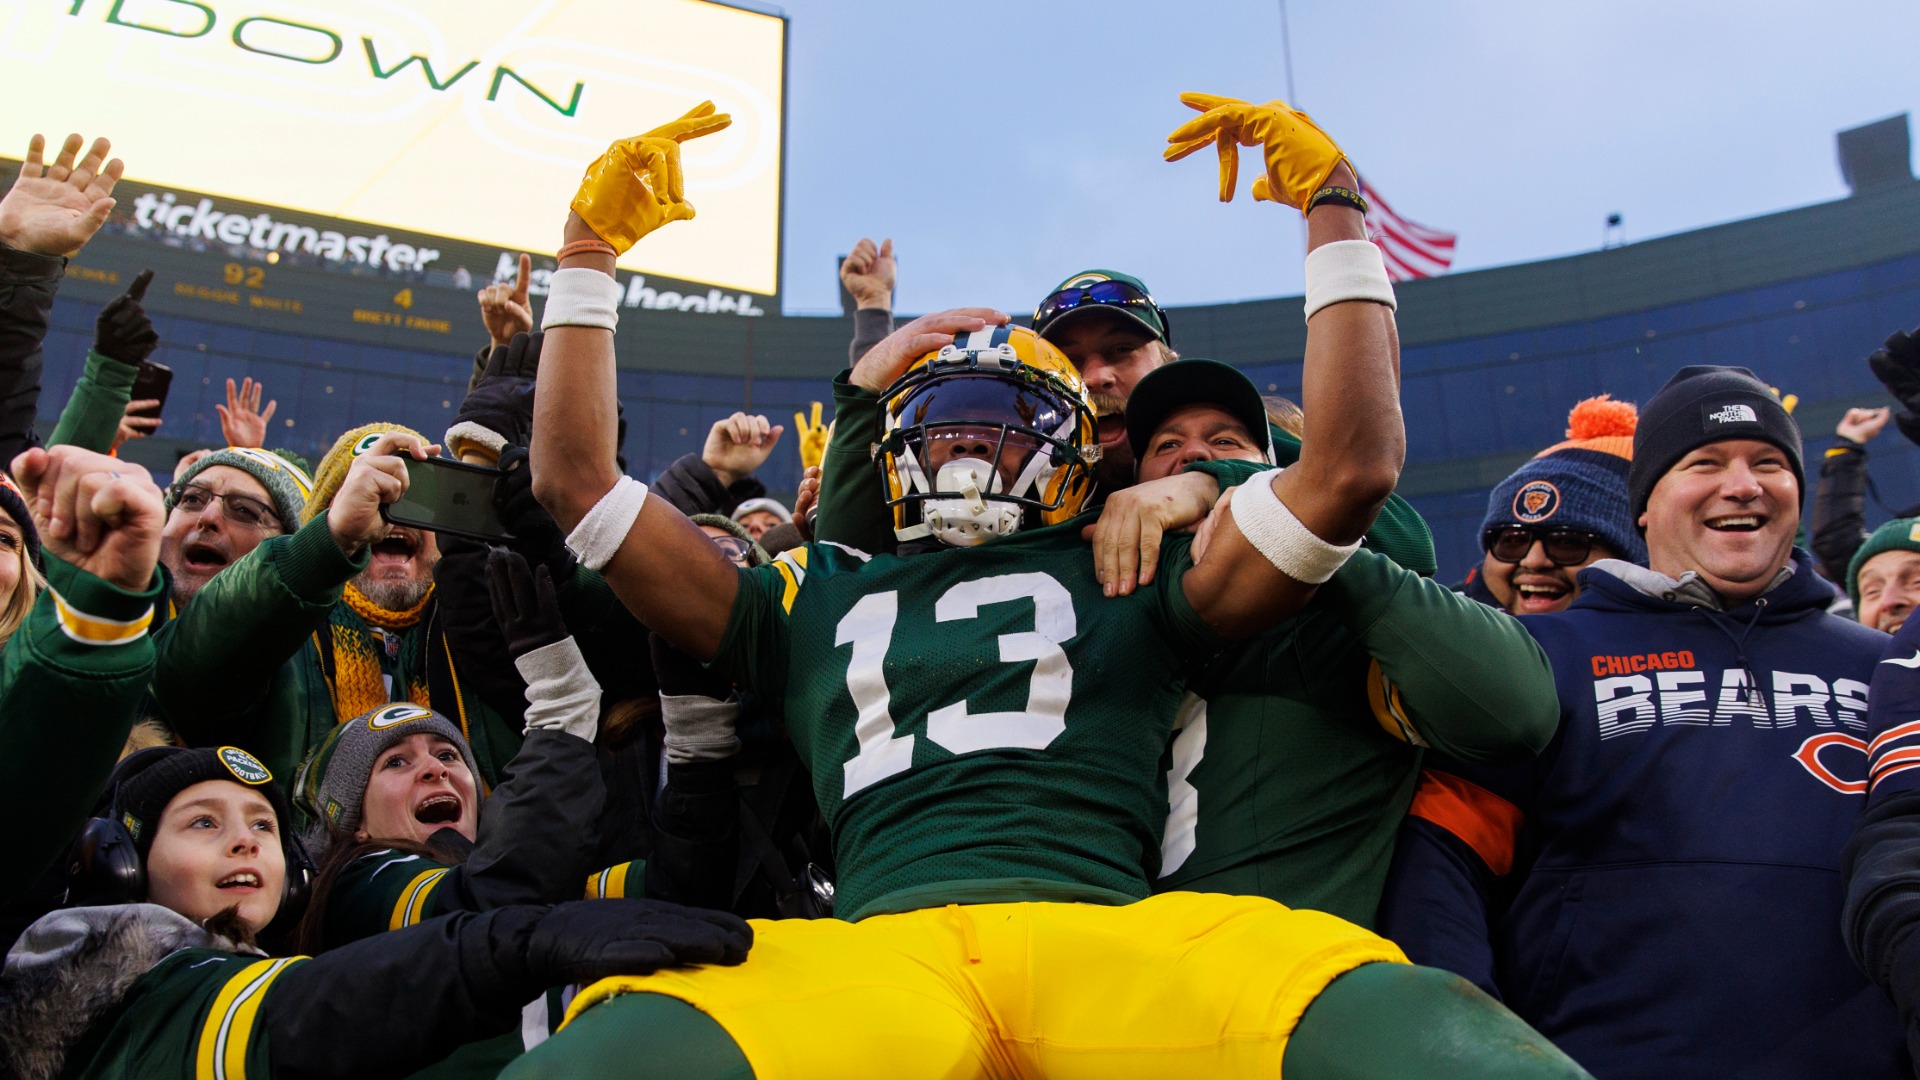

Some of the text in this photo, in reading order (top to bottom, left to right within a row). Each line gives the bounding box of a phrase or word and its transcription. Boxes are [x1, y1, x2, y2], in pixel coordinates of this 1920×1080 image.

[67, 0, 584, 117] DOWN
[134, 193, 440, 272] ticketmaster
[224, 262, 265, 289] 92
[393, 288, 413, 309] 4
[1709, 410, 1742, 420] NORTH
[1719, 416, 1742, 424] FACE
[1591, 650, 1696, 677] CHICAGO
[834, 571, 1077, 800] 13
[1594, 668, 1869, 740] BEARS
